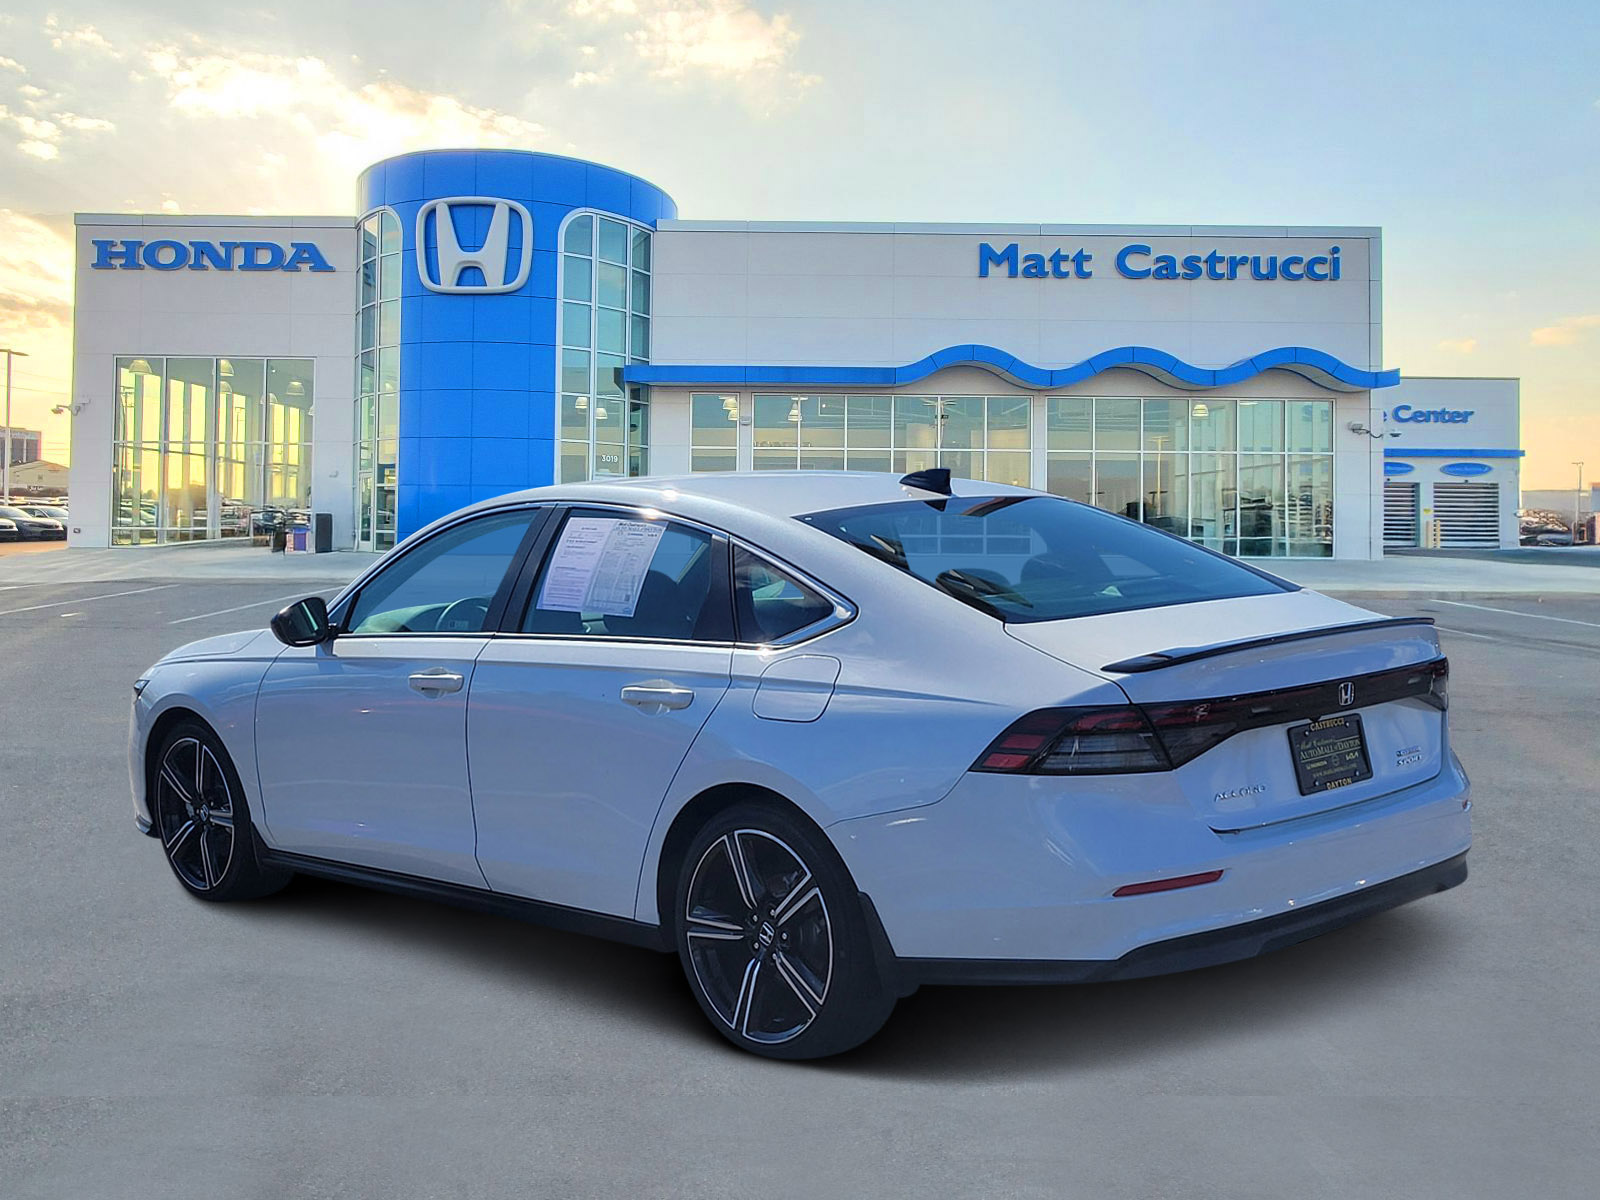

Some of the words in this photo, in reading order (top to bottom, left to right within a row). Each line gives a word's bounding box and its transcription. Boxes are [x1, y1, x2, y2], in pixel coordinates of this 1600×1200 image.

[91, 239, 336, 272] HONDA
[979, 242, 1093, 279] Matt
[1115, 244, 1342, 281] Castrucci
[1392, 404, 1475, 423] Center
[601, 454, 619, 463] 3019
[1326, 777, 1352, 790] DAYTON
